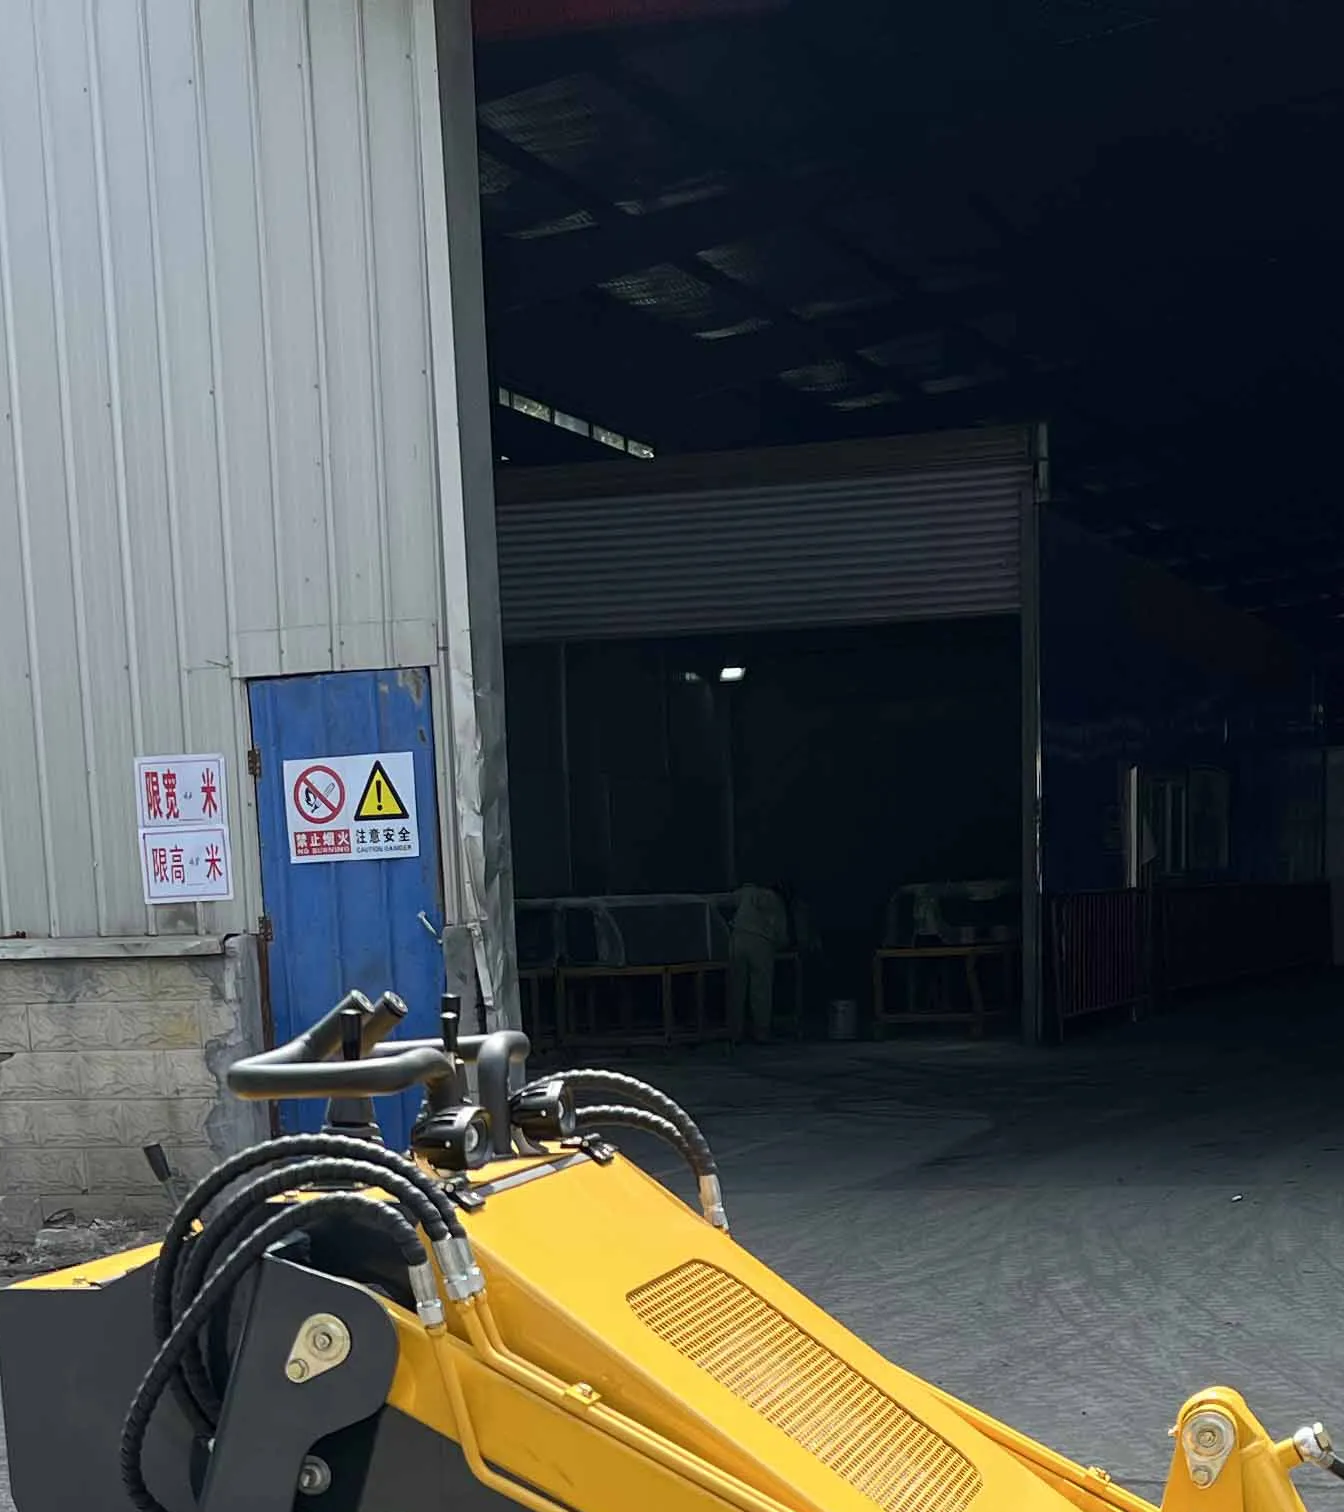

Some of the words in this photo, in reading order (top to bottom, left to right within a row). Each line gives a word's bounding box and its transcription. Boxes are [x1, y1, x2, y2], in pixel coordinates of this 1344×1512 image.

[145, 768, 179, 820] 限宽
[201, 768, 217, 818] 米
[296, 831, 349, 848] 禁止烟火
[356, 827, 410, 844] 注意安全
[152, 844, 185, 884] 限高
[205, 843, 223, 881] 米
